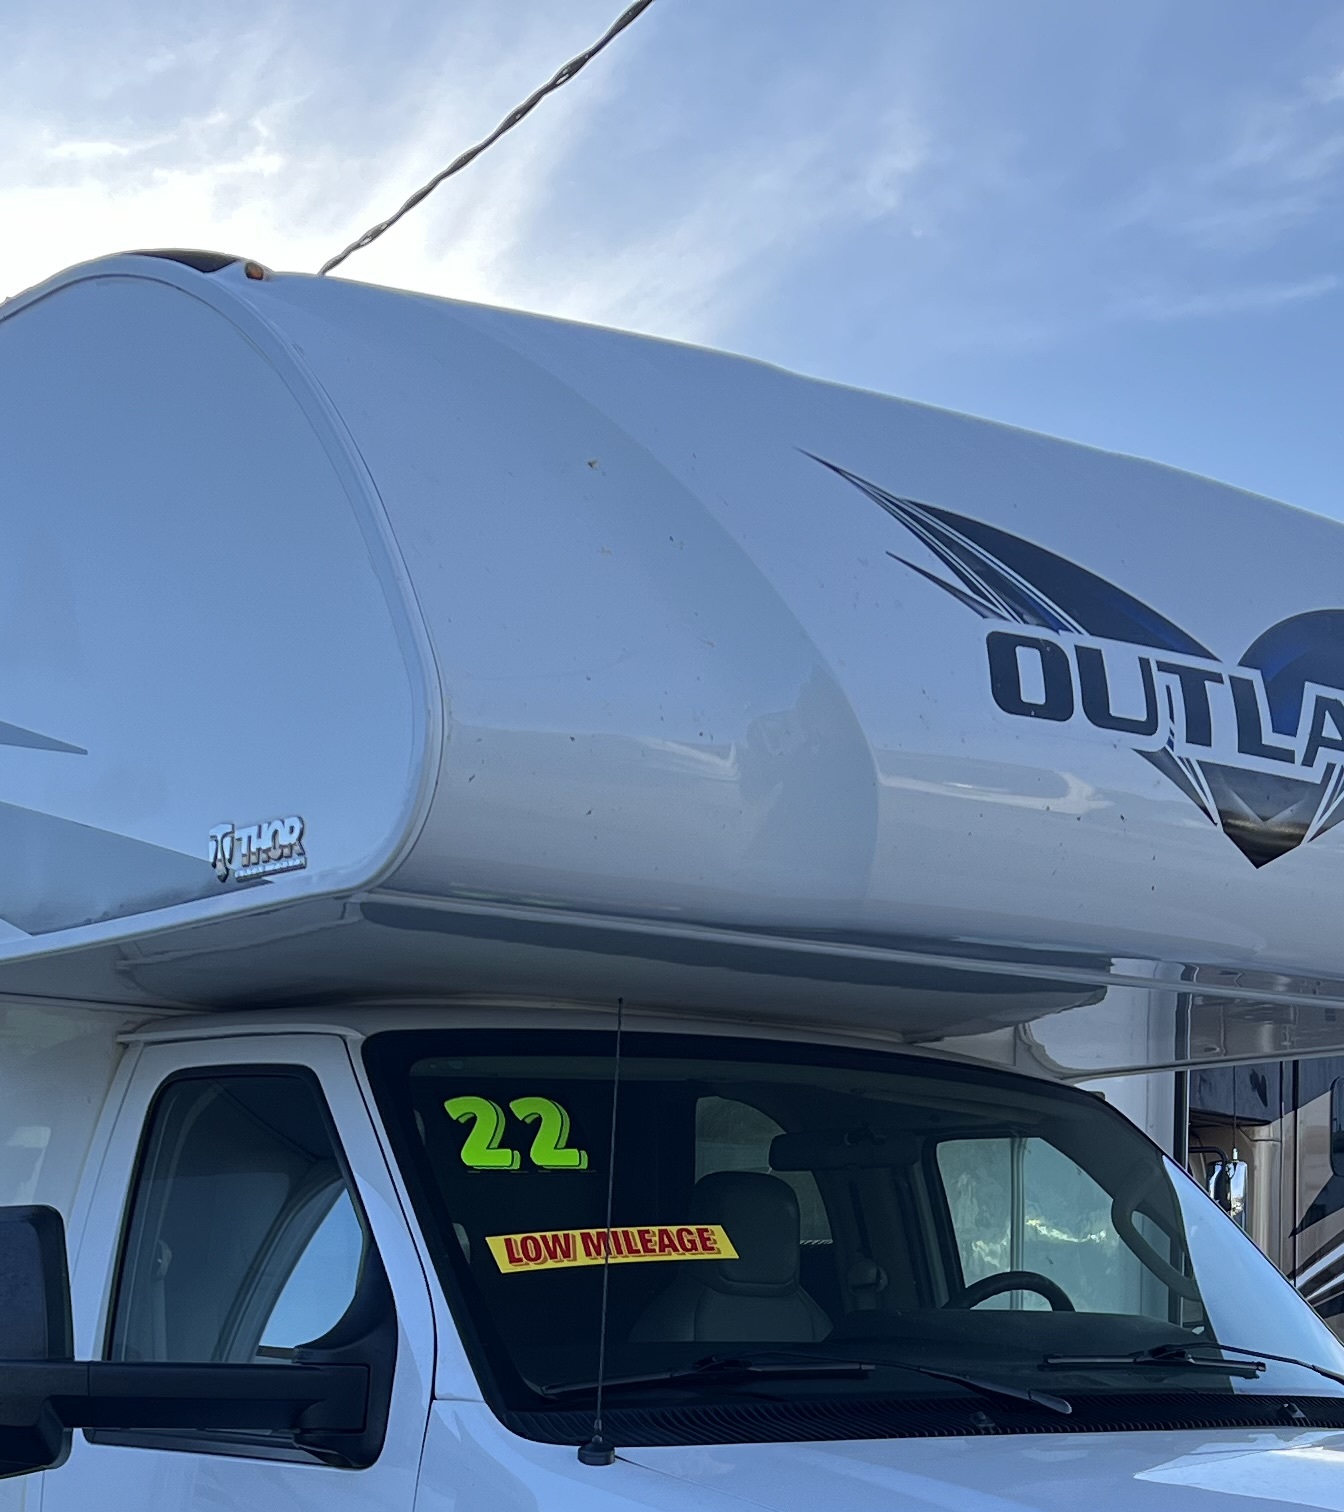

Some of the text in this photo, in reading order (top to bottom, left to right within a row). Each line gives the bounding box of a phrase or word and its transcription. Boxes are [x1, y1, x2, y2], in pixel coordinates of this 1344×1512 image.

[234, 816, 305, 867] THOR
[444, 1096, 588, 1169] 22
[504, 1227, 720, 1267] LOW MILEAGE
